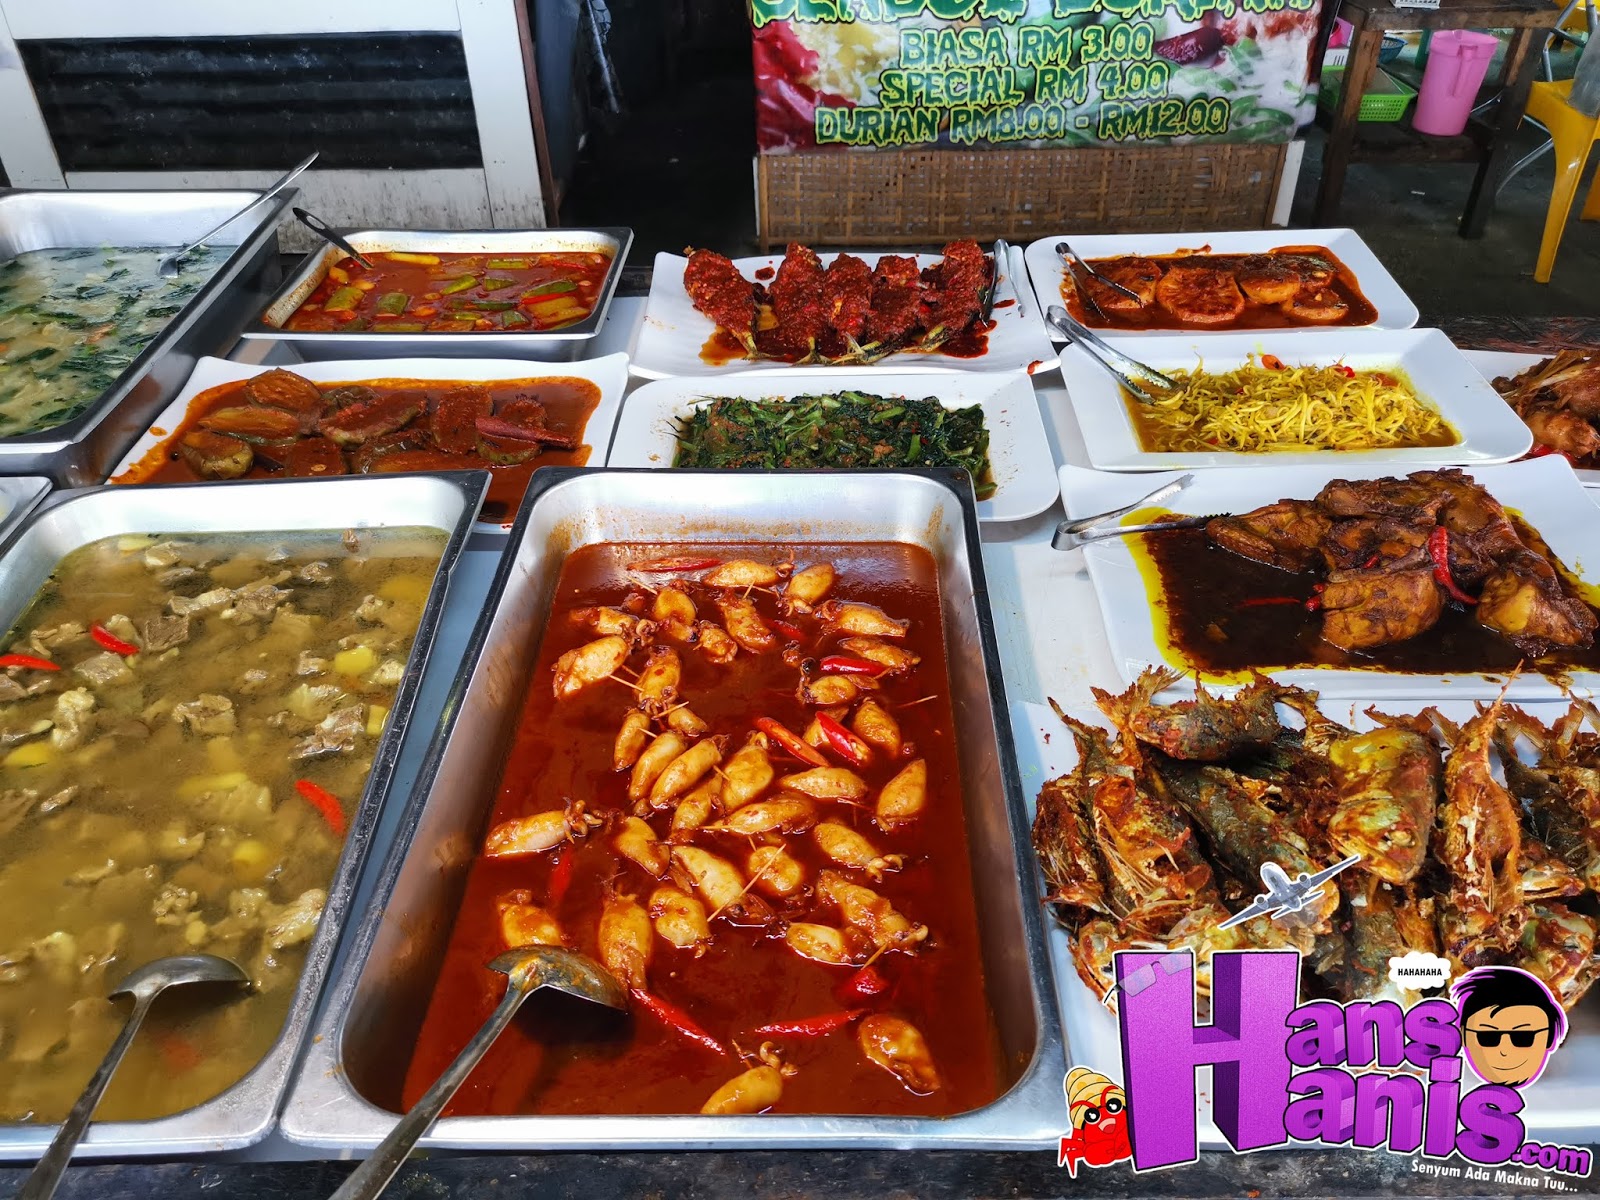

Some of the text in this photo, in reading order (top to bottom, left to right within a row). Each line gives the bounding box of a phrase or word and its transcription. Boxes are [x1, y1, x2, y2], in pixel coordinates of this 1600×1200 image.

[899, 23, 1153, 67] BIASA RM 3.00
[879, 62, 1170, 107] SPECIAL RM 4.00
[814, 105, 940, 145] DURIAN
[949, 105, 1066, 142] RM8.00
[1099, 99, 1230, 138] RM12.00
